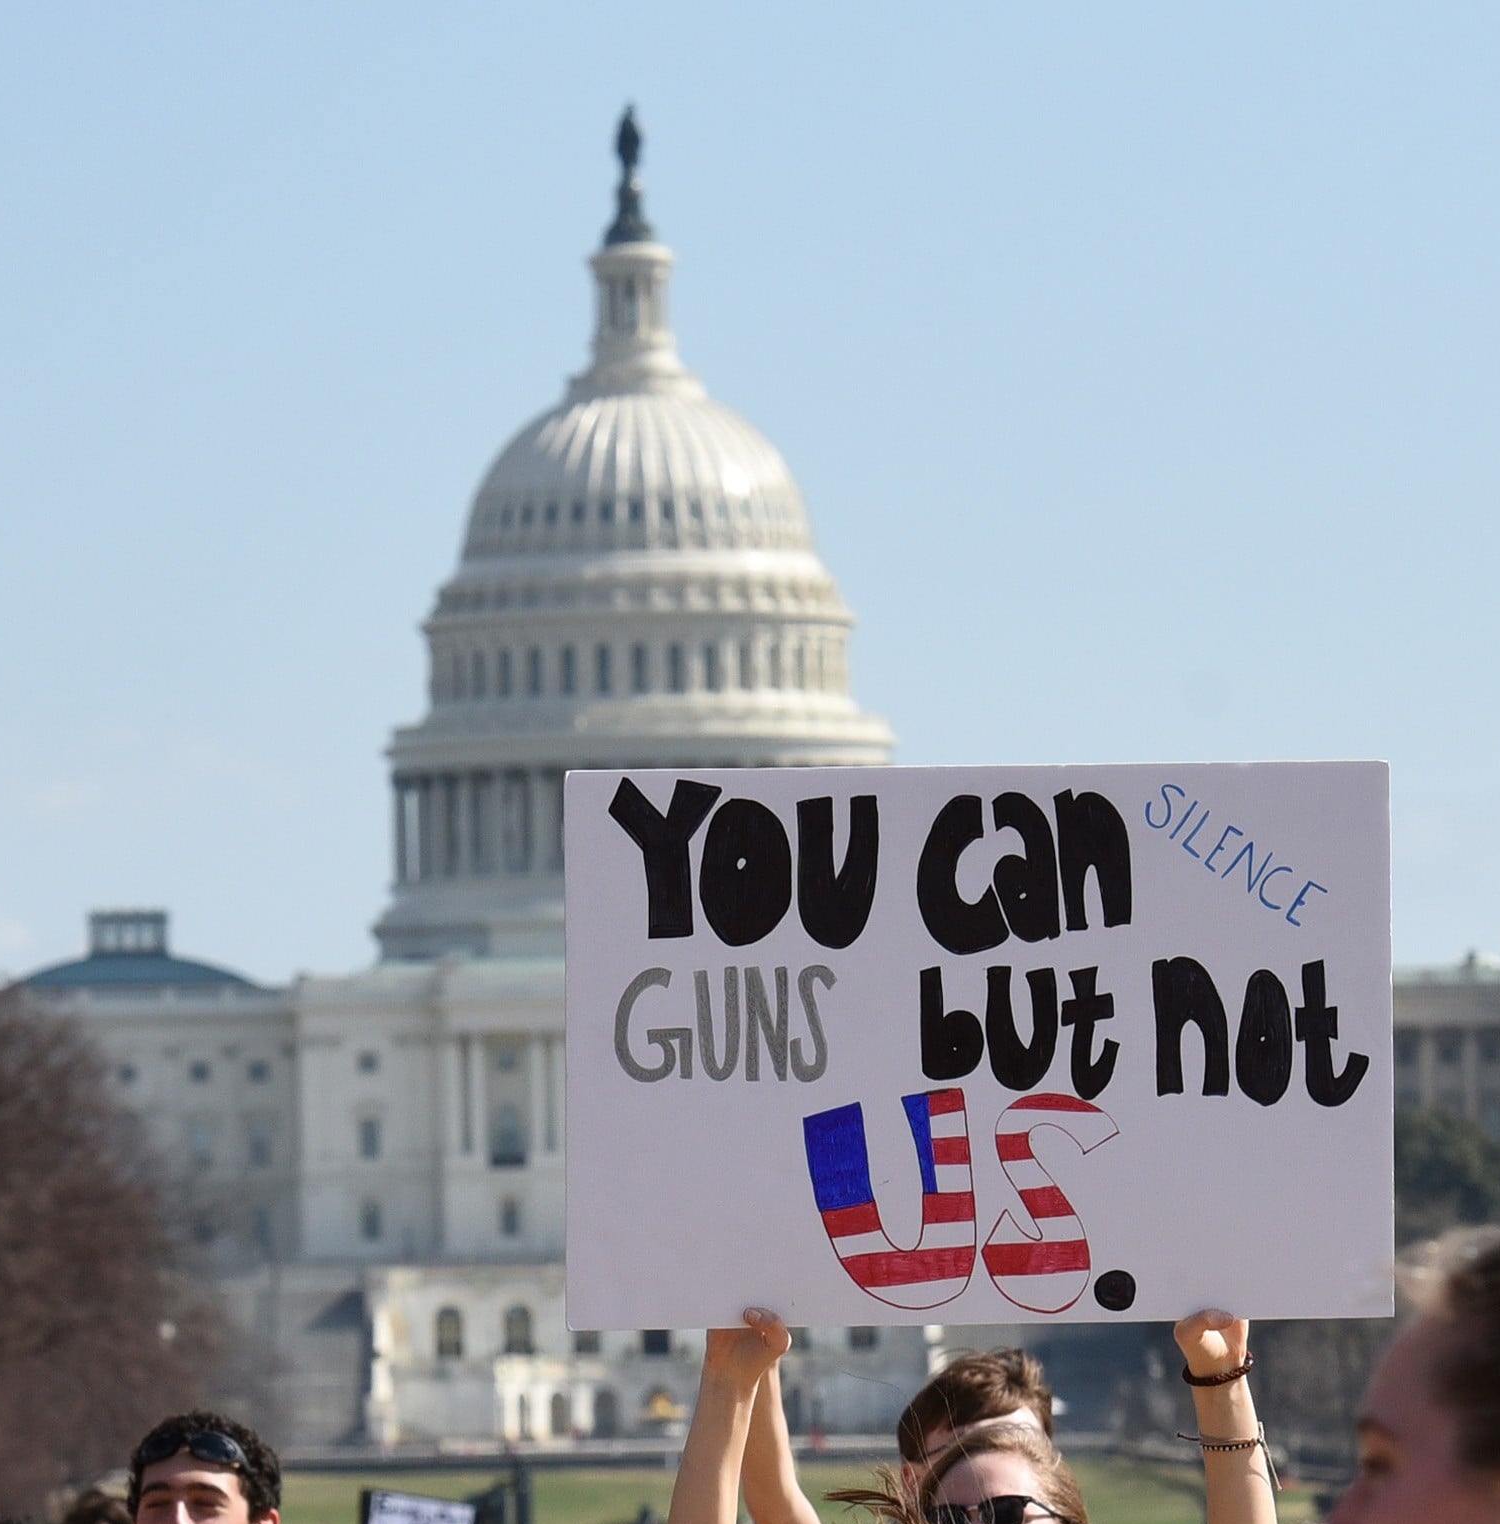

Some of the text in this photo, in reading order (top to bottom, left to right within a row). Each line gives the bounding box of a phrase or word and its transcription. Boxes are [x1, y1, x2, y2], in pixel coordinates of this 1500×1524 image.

[608, 777, 879, 949] YOU
[1145, 784, 1328, 927] SILENCE
[614, 964, 837, 1083] GUNS
[1152, 956, 1370, 1107] not
[803, 1087, 1137, 1313] US.
